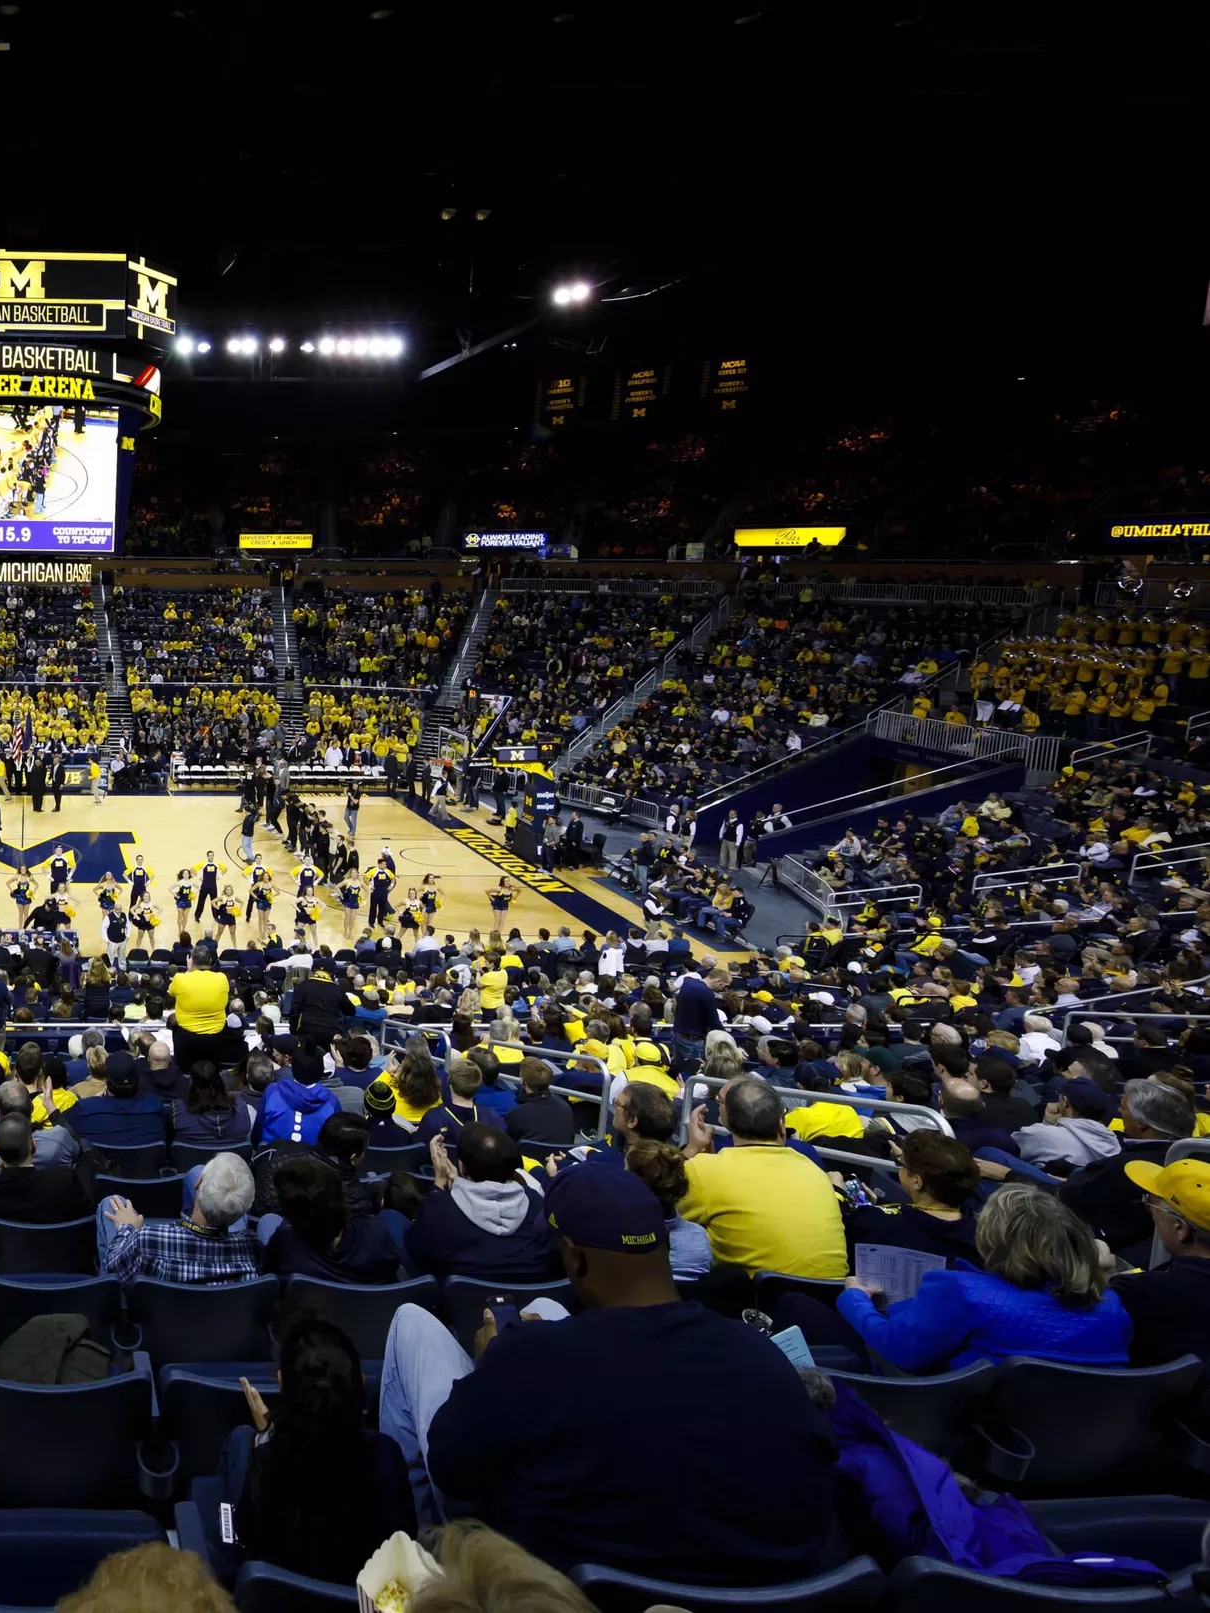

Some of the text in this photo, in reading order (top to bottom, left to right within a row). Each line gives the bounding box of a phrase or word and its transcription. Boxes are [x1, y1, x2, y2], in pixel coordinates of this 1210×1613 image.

[137, 273, 168, 317] M
[13, 306, 90, 323] BASKETBALL
[2, 346, 99, 374] BASKETBALL
[28, 375, 95, 400] ARENA
[633, 408, 646, 418] M
[552, 416, 564, 425] M
[121, 436, 135, 450] M
[53, 527, 112, 537] COUNTDOWN
[57, 536, 108, 545] TO TIP-OFF
[510, 750, 525, 761] M
[537, 803, 555, 811] meijer
[445, 828, 575, 893] MICHIGAN
[621, 1232, 657, 1244] MICHIGAN
